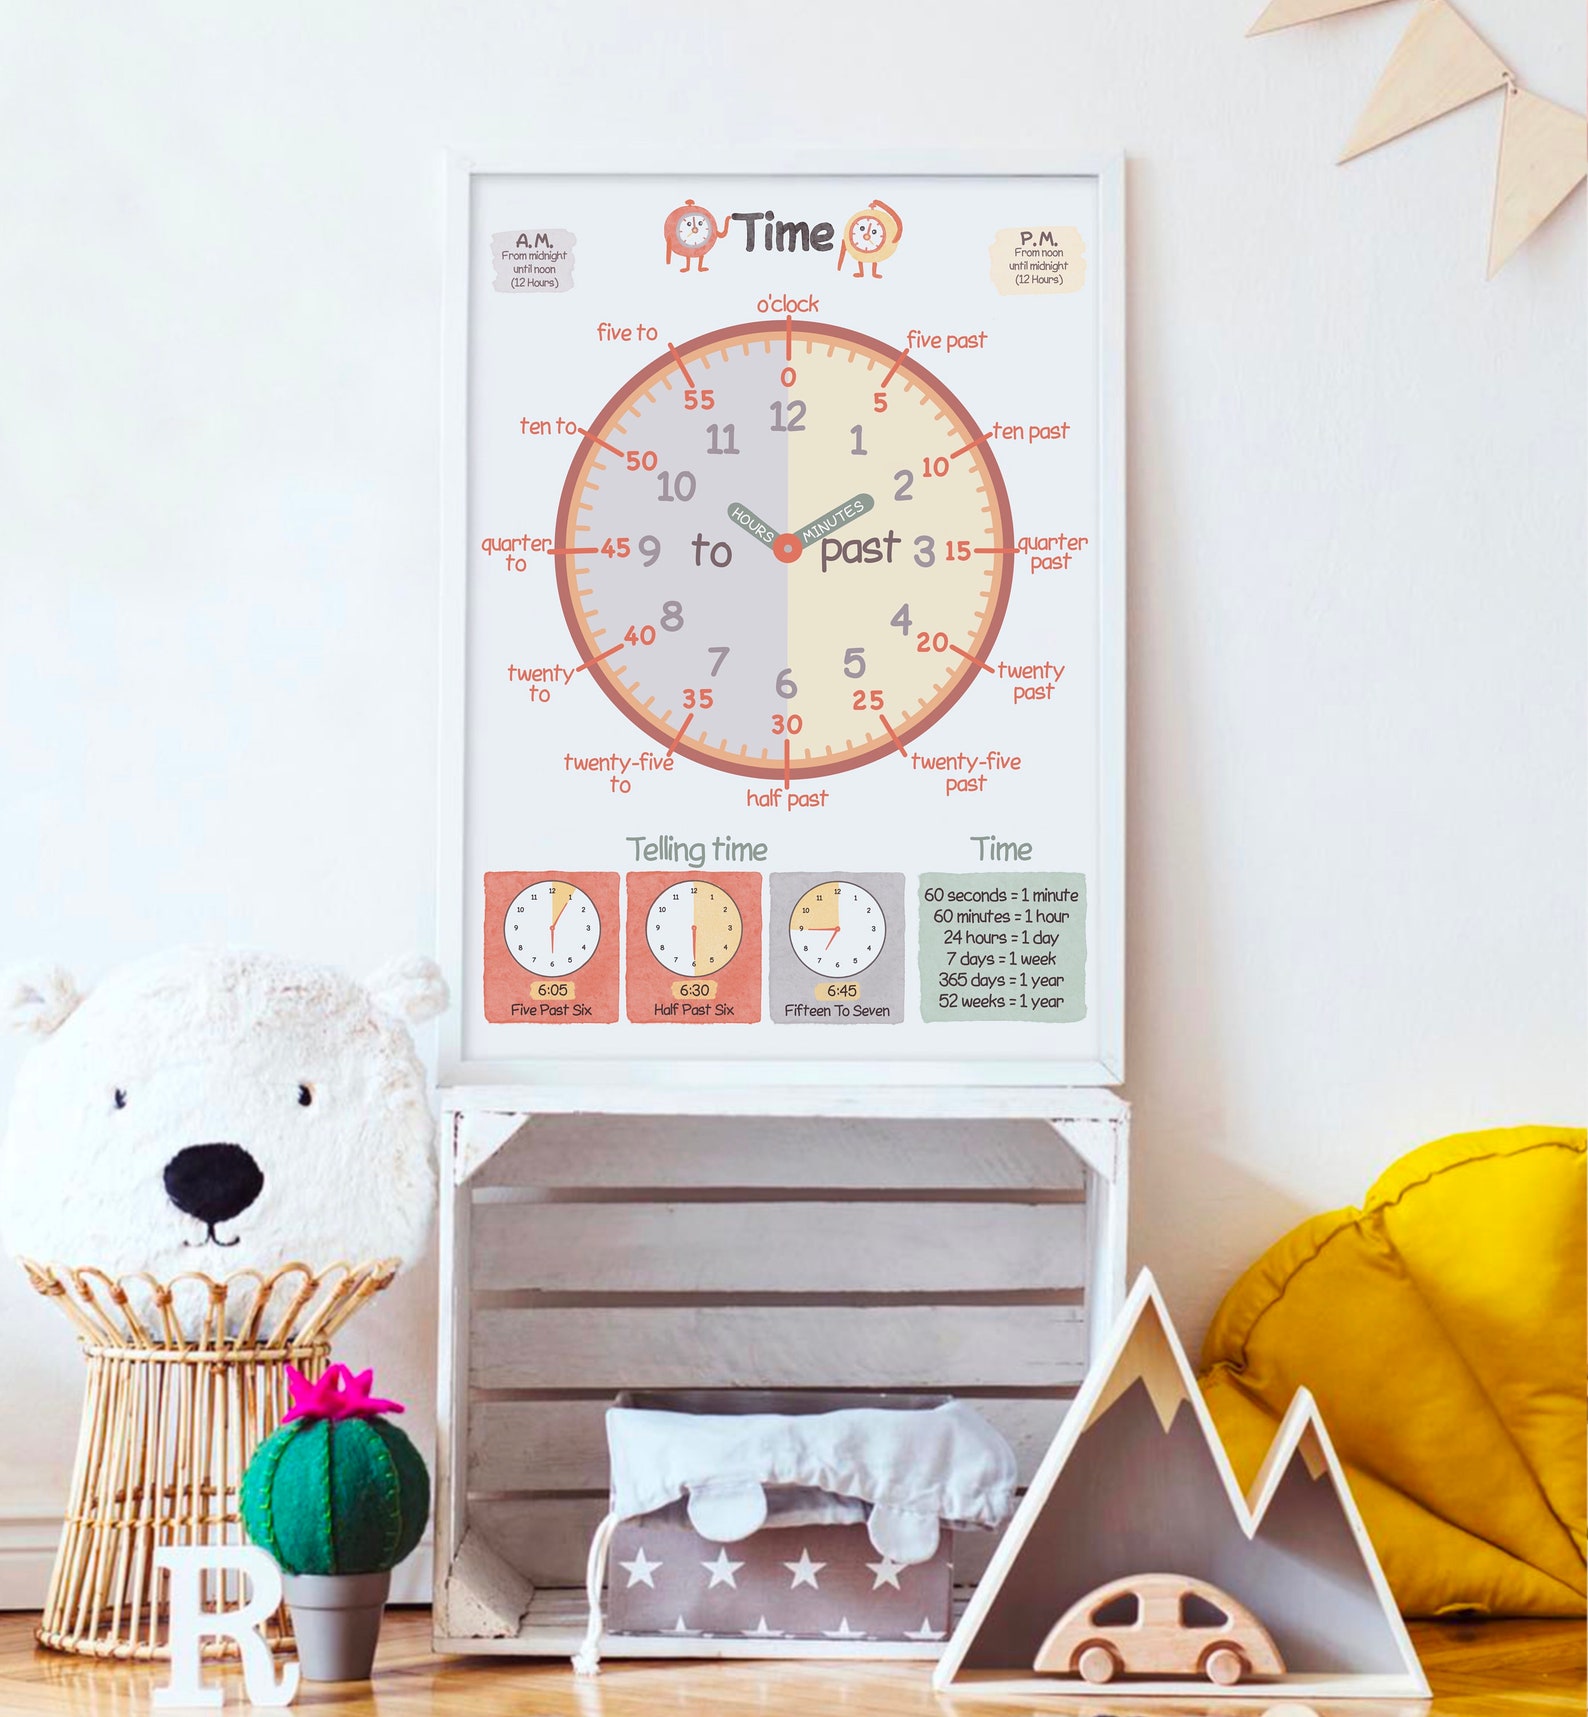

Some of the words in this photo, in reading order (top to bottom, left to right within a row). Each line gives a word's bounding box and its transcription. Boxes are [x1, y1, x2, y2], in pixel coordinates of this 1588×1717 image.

[731, 210, 834, 252] Time
[502, 251, 527, 260] From
[529, 251, 567, 263] midnight
[1015, 248, 1039, 257] From
[1042, 249, 1063, 257] noon
[514, 265, 532, 273] until
[534, 266, 555, 274] noon
[1009, 262, 1028, 270] until
[1030, 261, 1068, 272] midnight
[511, 278, 525, 289] (12
[527, 279, 559, 288] Hours)
[1016, 276, 1030, 285] (12
[1032, 275, 1063, 285] Hours)
[757, 294, 820, 313] o'clock
[597, 323, 631, 341] five
[637, 324, 658, 340] to
[907, 331, 941, 349] five
[947, 331, 987, 353] past
[781, 367, 796, 387] 0
[684, 390, 714, 409] 55
[874, 392, 887, 412] 5
[520, 417, 551, 434] ten
[556, 417, 577, 434] to
[770, 400, 807, 431] 12
[706, 424, 740, 454] 11
[851, 425, 867, 455] 1
[993, 422, 1024, 439] ten
[1029, 422, 1070, 443] past
[627, 451, 657, 471] 50
[923, 457, 949, 477] 10
[657, 471, 696, 501] 10
[894, 470, 913, 501] 2
[731, 507, 774, 543] HOURS
[802, 501, 865, 543] MINUTES
[482, 535, 552, 555] quarter
[601, 538, 630, 558] 45
[638, 535, 660, 567] 9
[692, 533, 732, 567] to
[821, 530, 901, 572] past
[914, 535, 935, 567] 3
[946, 541, 971, 561] 15
[1018, 533, 1088, 553] quarter
[506, 554, 526, 571] to
[1031, 552, 1072, 574] past
[661, 601, 684, 632] 8
[890, 603, 912, 636] 4
[624, 625, 656, 645] 40
[917, 632, 948, 652] 20
[708, 647, 730, 677] 7
[844, 648, 866, 678] 5
[998, 661, 1065, 682] twenty
[508, 664, 575, 684] twenty
[776, 668, 798, 699] 6
[529, 685, 550, 702] to
[683, 689, 713, 709] 35
[853, 690, 884, 710] 25
[1014, 682, 1055, 704] past
[772, 714, 802, 735] 30
[564, 752, 674, 774] twenty-five
[912, 751, 1021, 773] twenty-five
[610, 776, 631, 793] to
[946, 775, 987, 796] past
[747, 788, 782, 808] half
[788, 790, 829, 811] past
[626, 836, 706, 868] Telling
[712, 836, 768, 862] time
[970, 836, 1032, 861] Time
[924, 888, 943, 902] 60
[948, 888, 1007, 902] seconds
[1022, 888, 1029, 902] 1
[1033, 889, 1079, 902] minute
[934, 910, 953, 923] 60
[957, 910, 1010, 924] minutes
[1026, 910, 1032, 923] 1
[1036, 910, 1069, 923] hour
[871, 925, 876, 933] 3
[944, 931, 962, 945] 24
[966, 931, 1007, 945] hours
[1022, 931, 1029, 944] 1
[1033, 931, 1059, 947] day
[947, 952, 956, 966] 7
[960, 952, 995, 968] days
[1009, 952, 1016, 965] 1
[1021, 952, 1056, 966] week
[538, 984, 568, 996] 6:05
[680, 984, 710, 996] 6:30
[827, 985, 857, 997] 6:45
[939, 973, 967, 987] 365
[971, 973, 1005, 989] days
[1020, 973, 1027, 987] 1
[1031, 977, 1064, 989] year
[511, 1003, 537, 1015] Five
[540, 1004, 569, 1016] Past
[572, 1004, 592, 1016] Six
[655, 1003, 679, 1015] Half
[682, 1004, 712, 1016] Past
[715, 1004, 734, 1015] Six
[785, 1004, 831, 1017] Fifteen
[834, 1005, 850, 1017] To
[853, 1005, 890, 1017] Seven
[939, 994, 958, 1008] 52
[962, 994, 1005, 1008] weeks
[1020, 994, 1027, 1008] 1
[1031, 998, 1064, 1011] year
[95, 1546, 300, 1708] R
